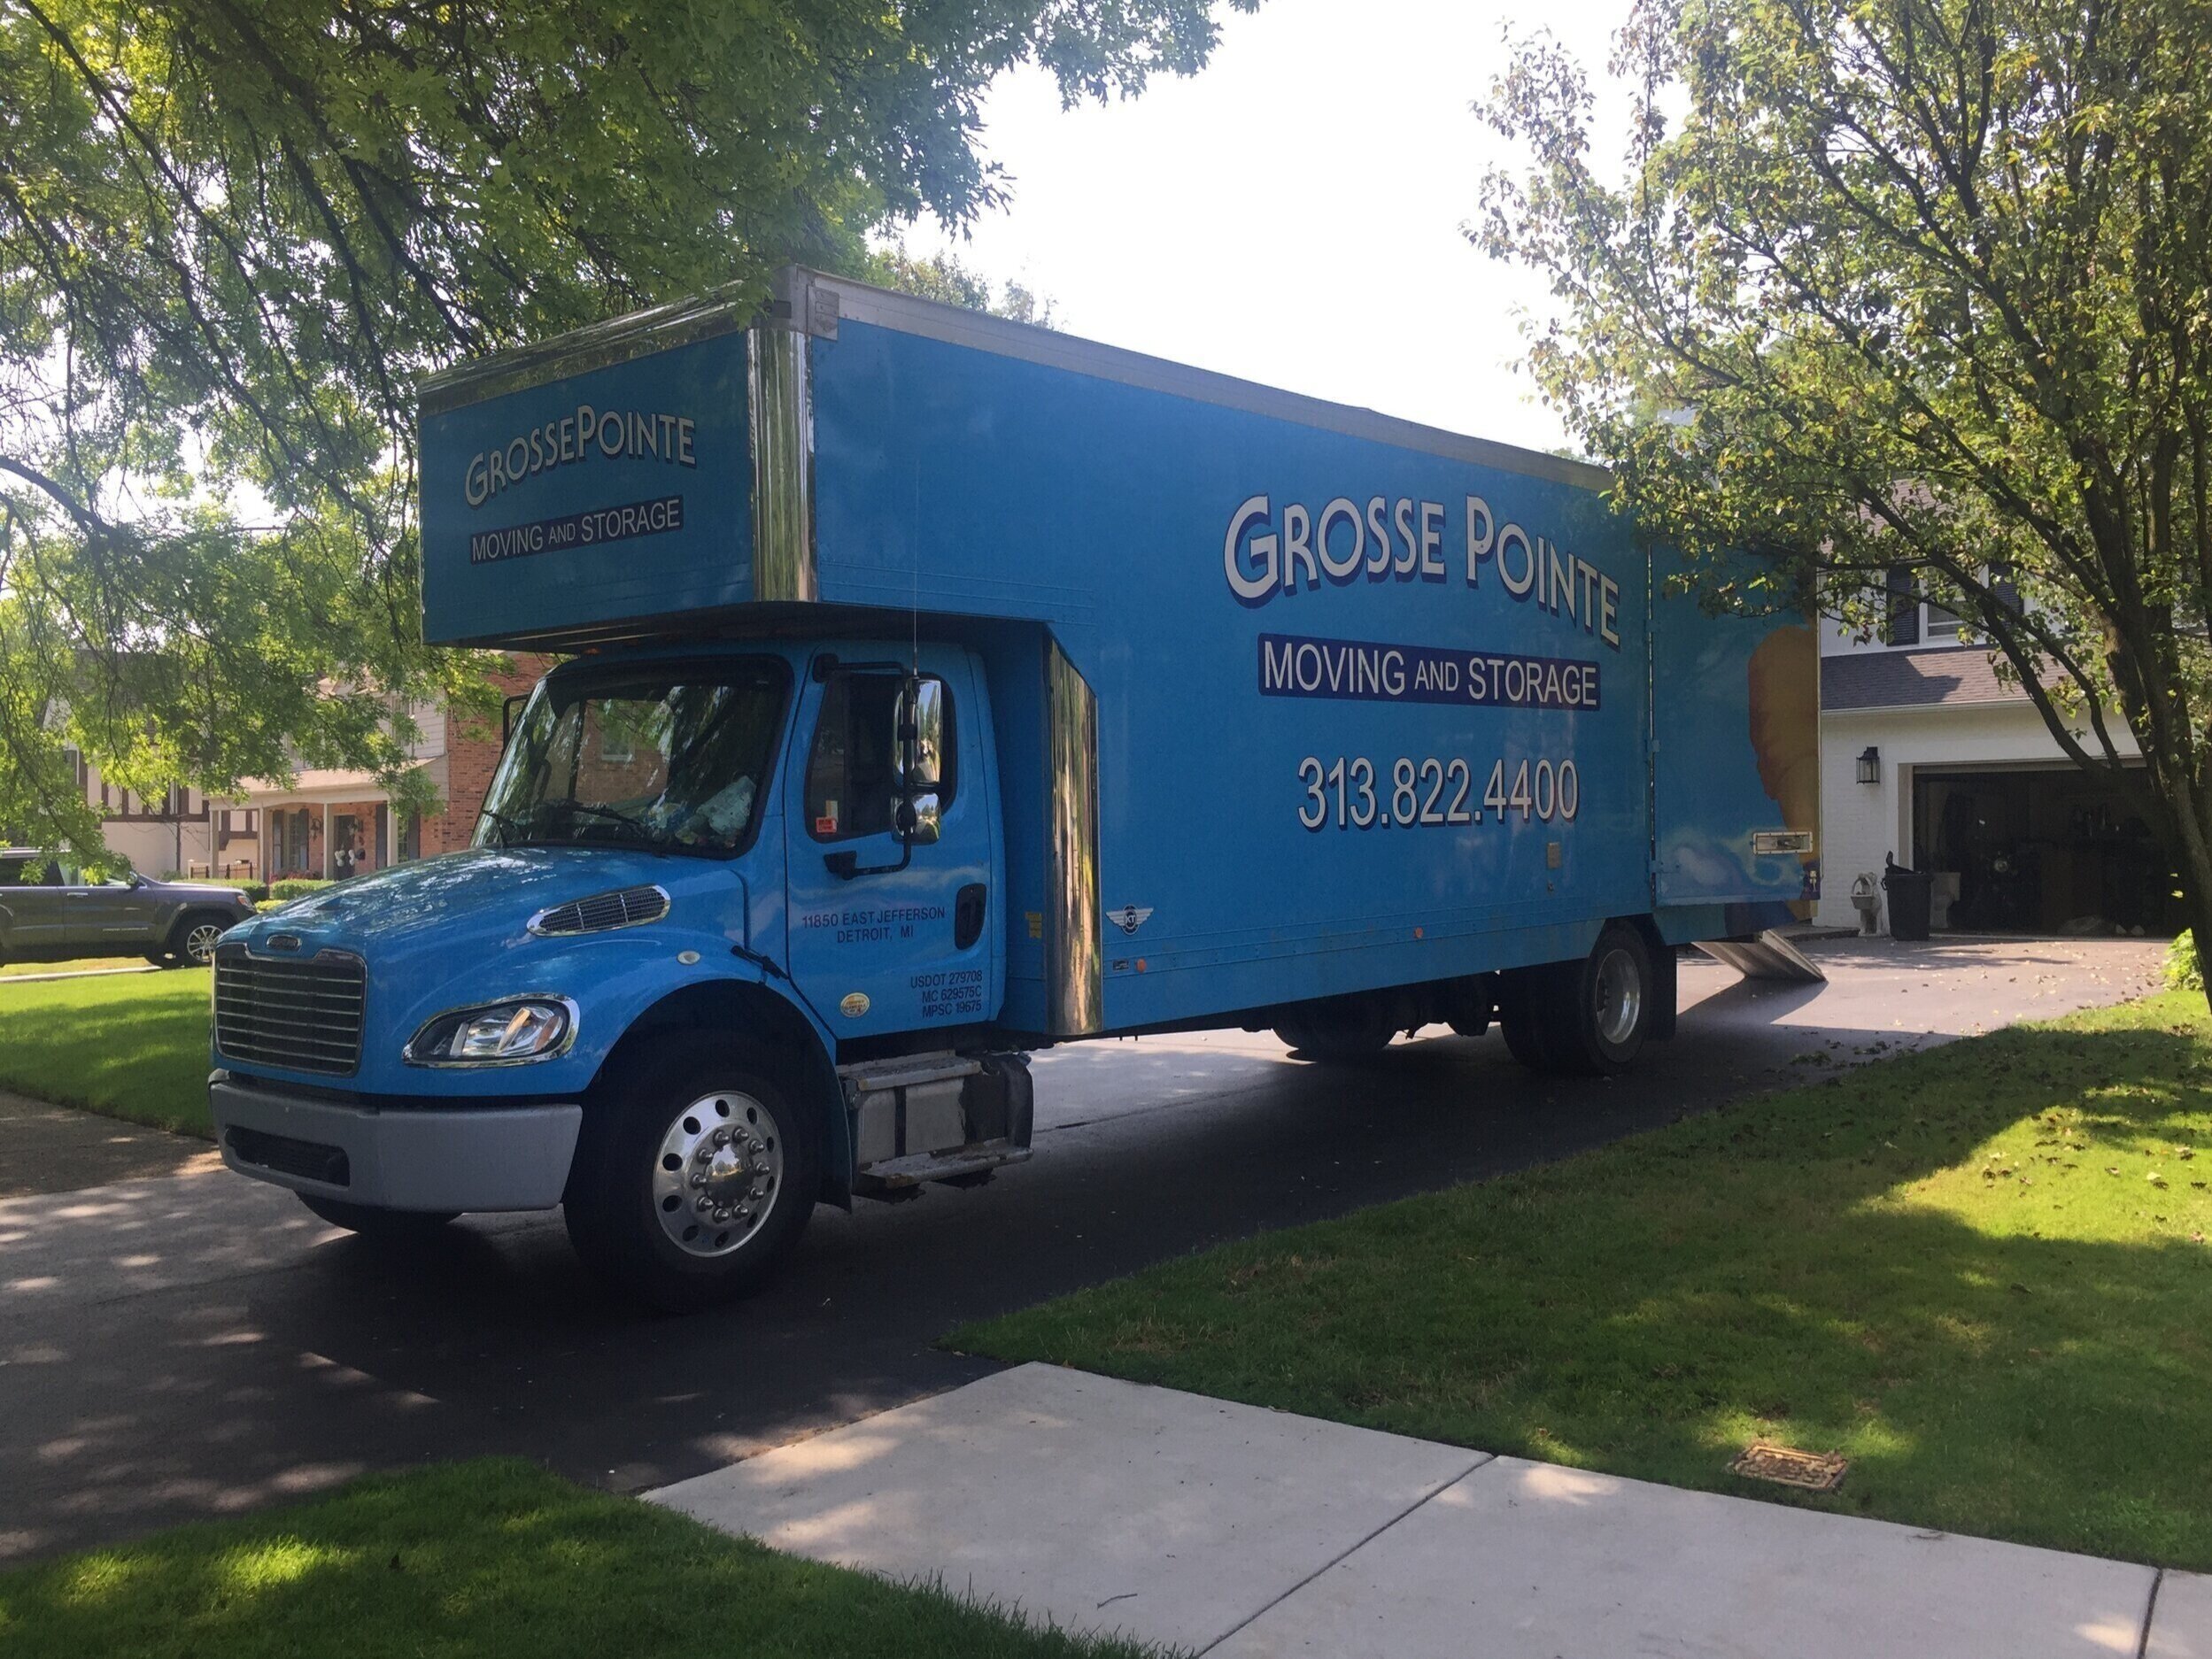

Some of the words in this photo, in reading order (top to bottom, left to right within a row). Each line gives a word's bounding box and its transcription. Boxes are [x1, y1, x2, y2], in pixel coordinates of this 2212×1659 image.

[472, 525, 543, 561] MOVING
[548, 523, 576, 545] AND
[581, 499, 680, 542] STORAGE
[1224, 493, 1446, 608] GROSSE
[1466, 493, 1620, 652] POINTE
[1264, 641, 1405, 695] MOVING
[1414, 660, 1458, 691] AND
[1468, 658, 1597, 706] STORAGE
[1297, 756, 1581, 832] 313.822.4400
[802, 914, 839, 929] 11850
[842, 911, 876, 926] EAST
[877, 907, 946, 923] JEFFERSON
[837, 927, 893, 944] DETROIT,
[901, 925, 914, 938] MI
[910, 974, 946, 989] USDOT
[948, 969, 983, 985] 279708
[922, 990, 939, 1003] MC
[922, 1002, 953, 1019] MPSC
[955, 999, 982, 1014] 19675
